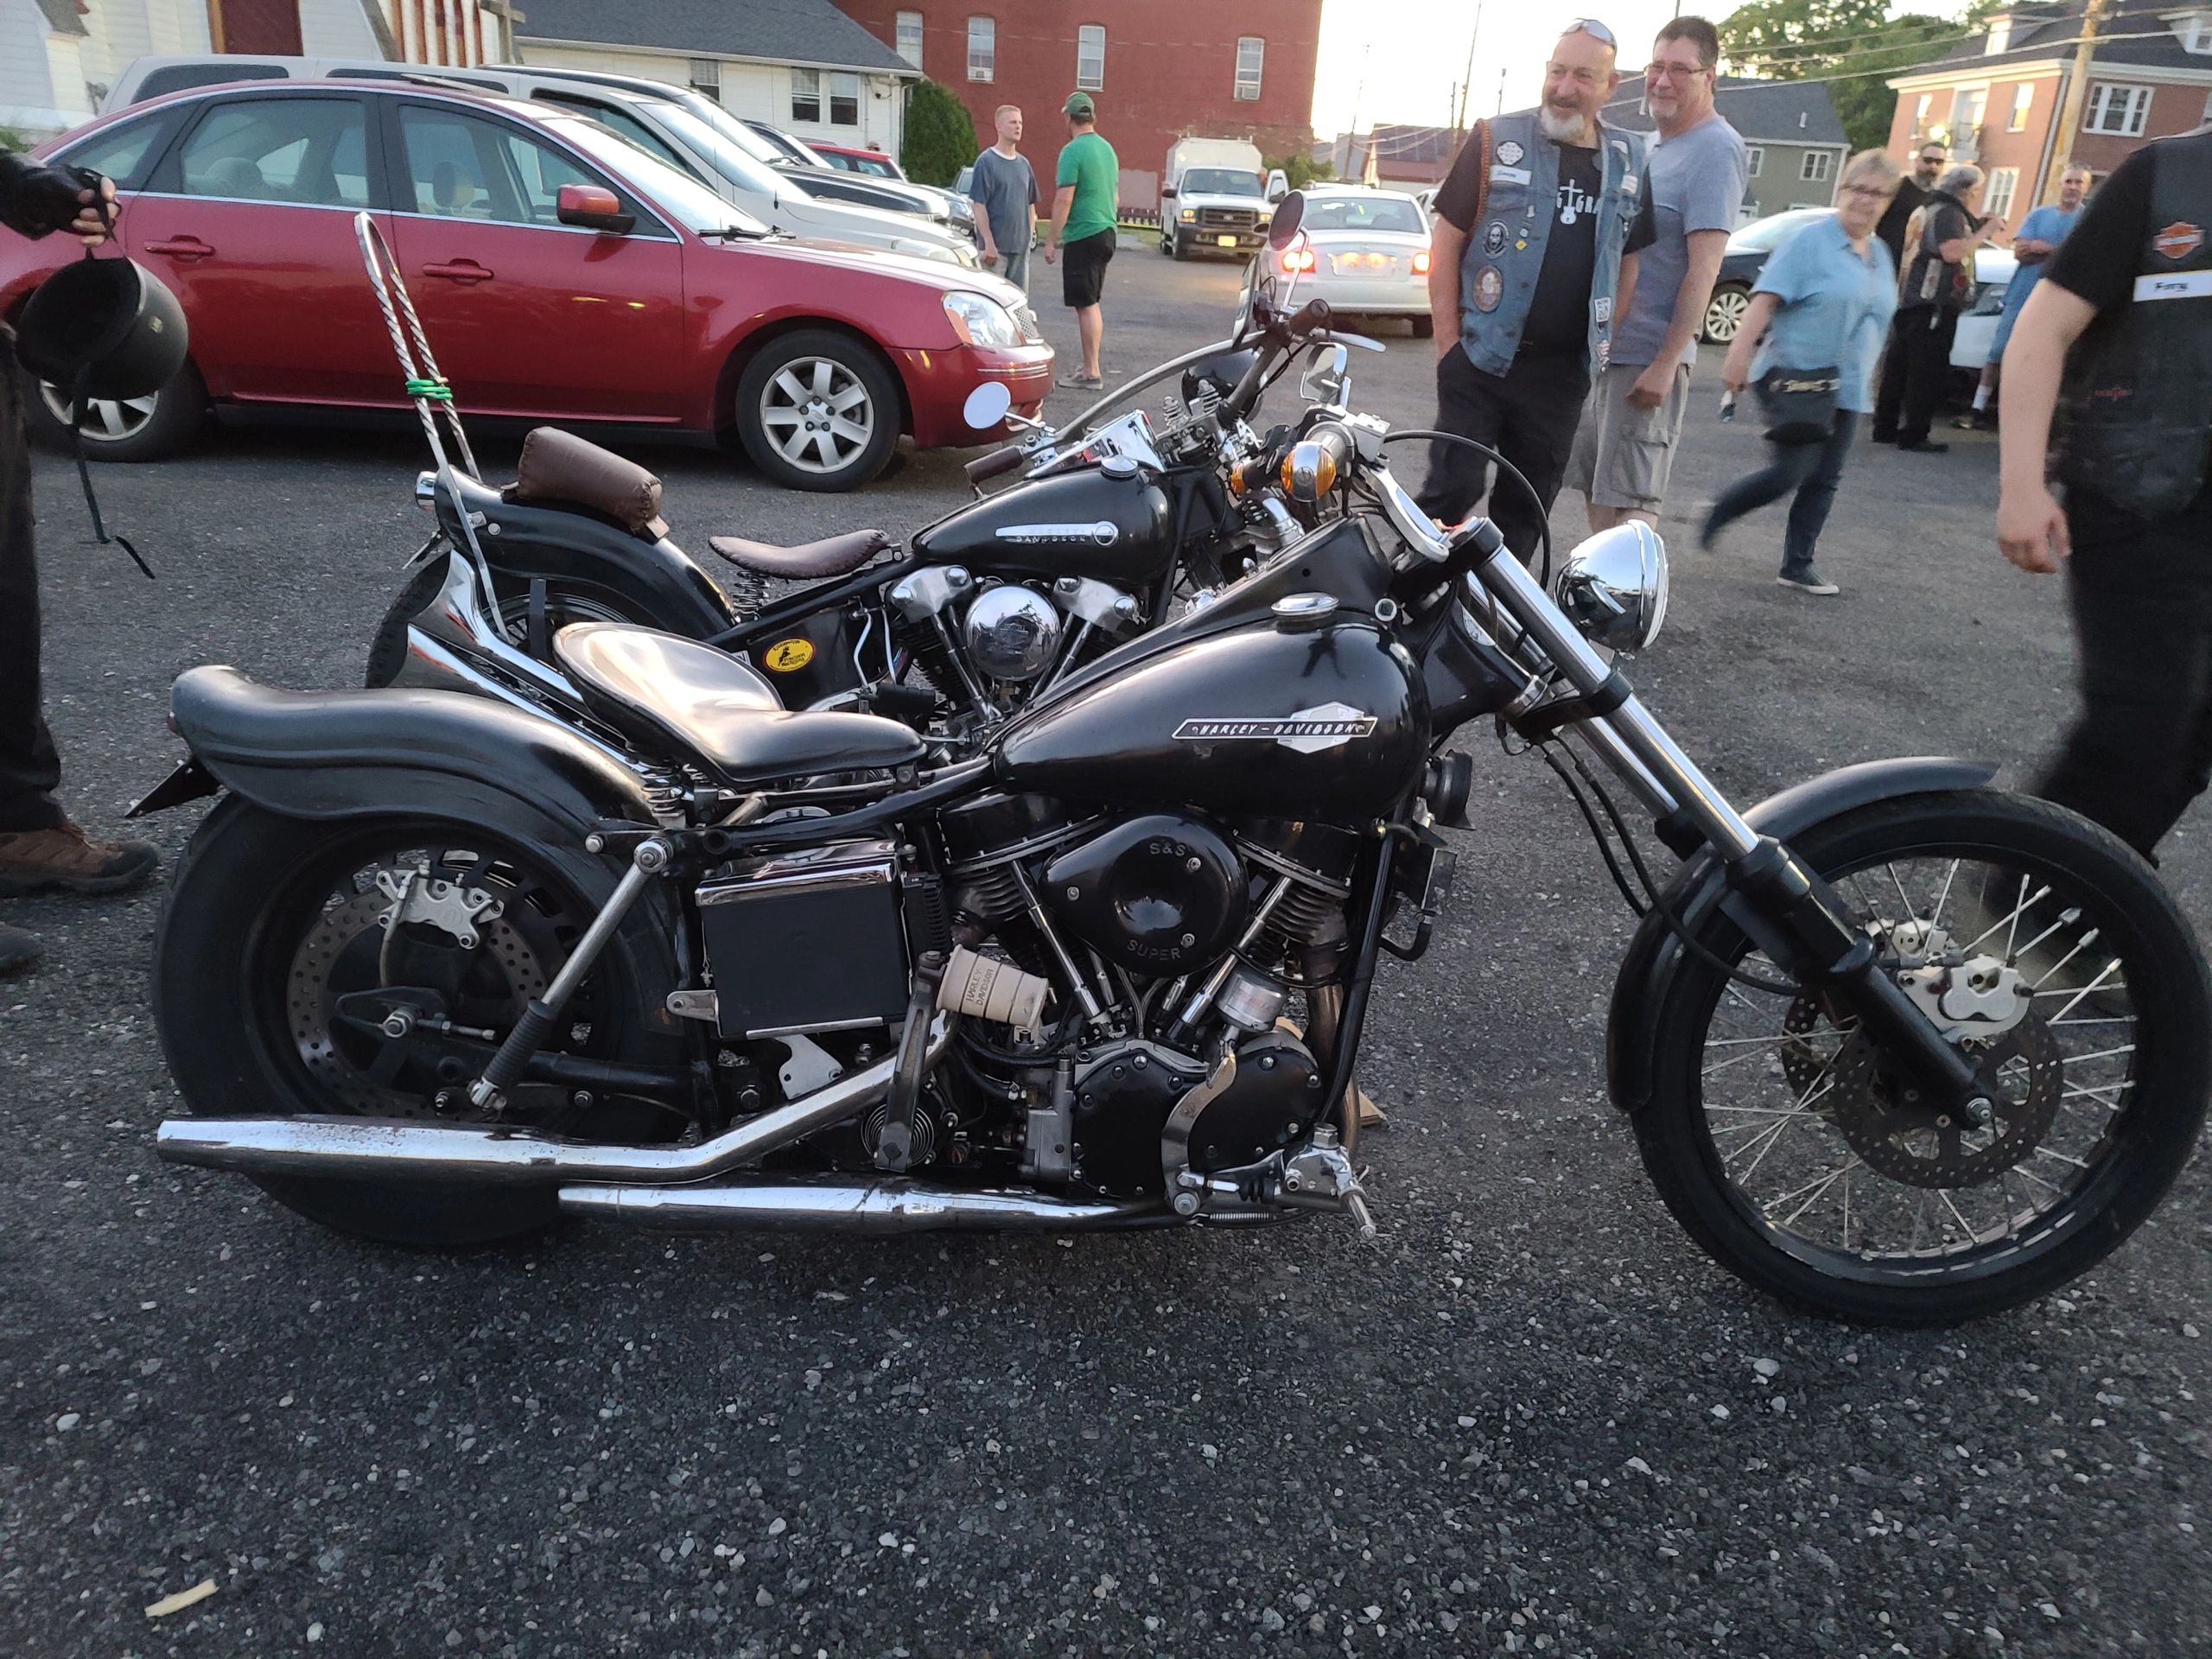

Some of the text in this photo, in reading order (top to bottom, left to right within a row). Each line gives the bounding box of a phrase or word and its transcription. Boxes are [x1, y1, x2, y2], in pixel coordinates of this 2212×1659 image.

[1149, 842, 1186, 857] S&S
[1127, 939, 1182, 961] SUPER
[976, 968, 994, 1006] DAVIDSON
